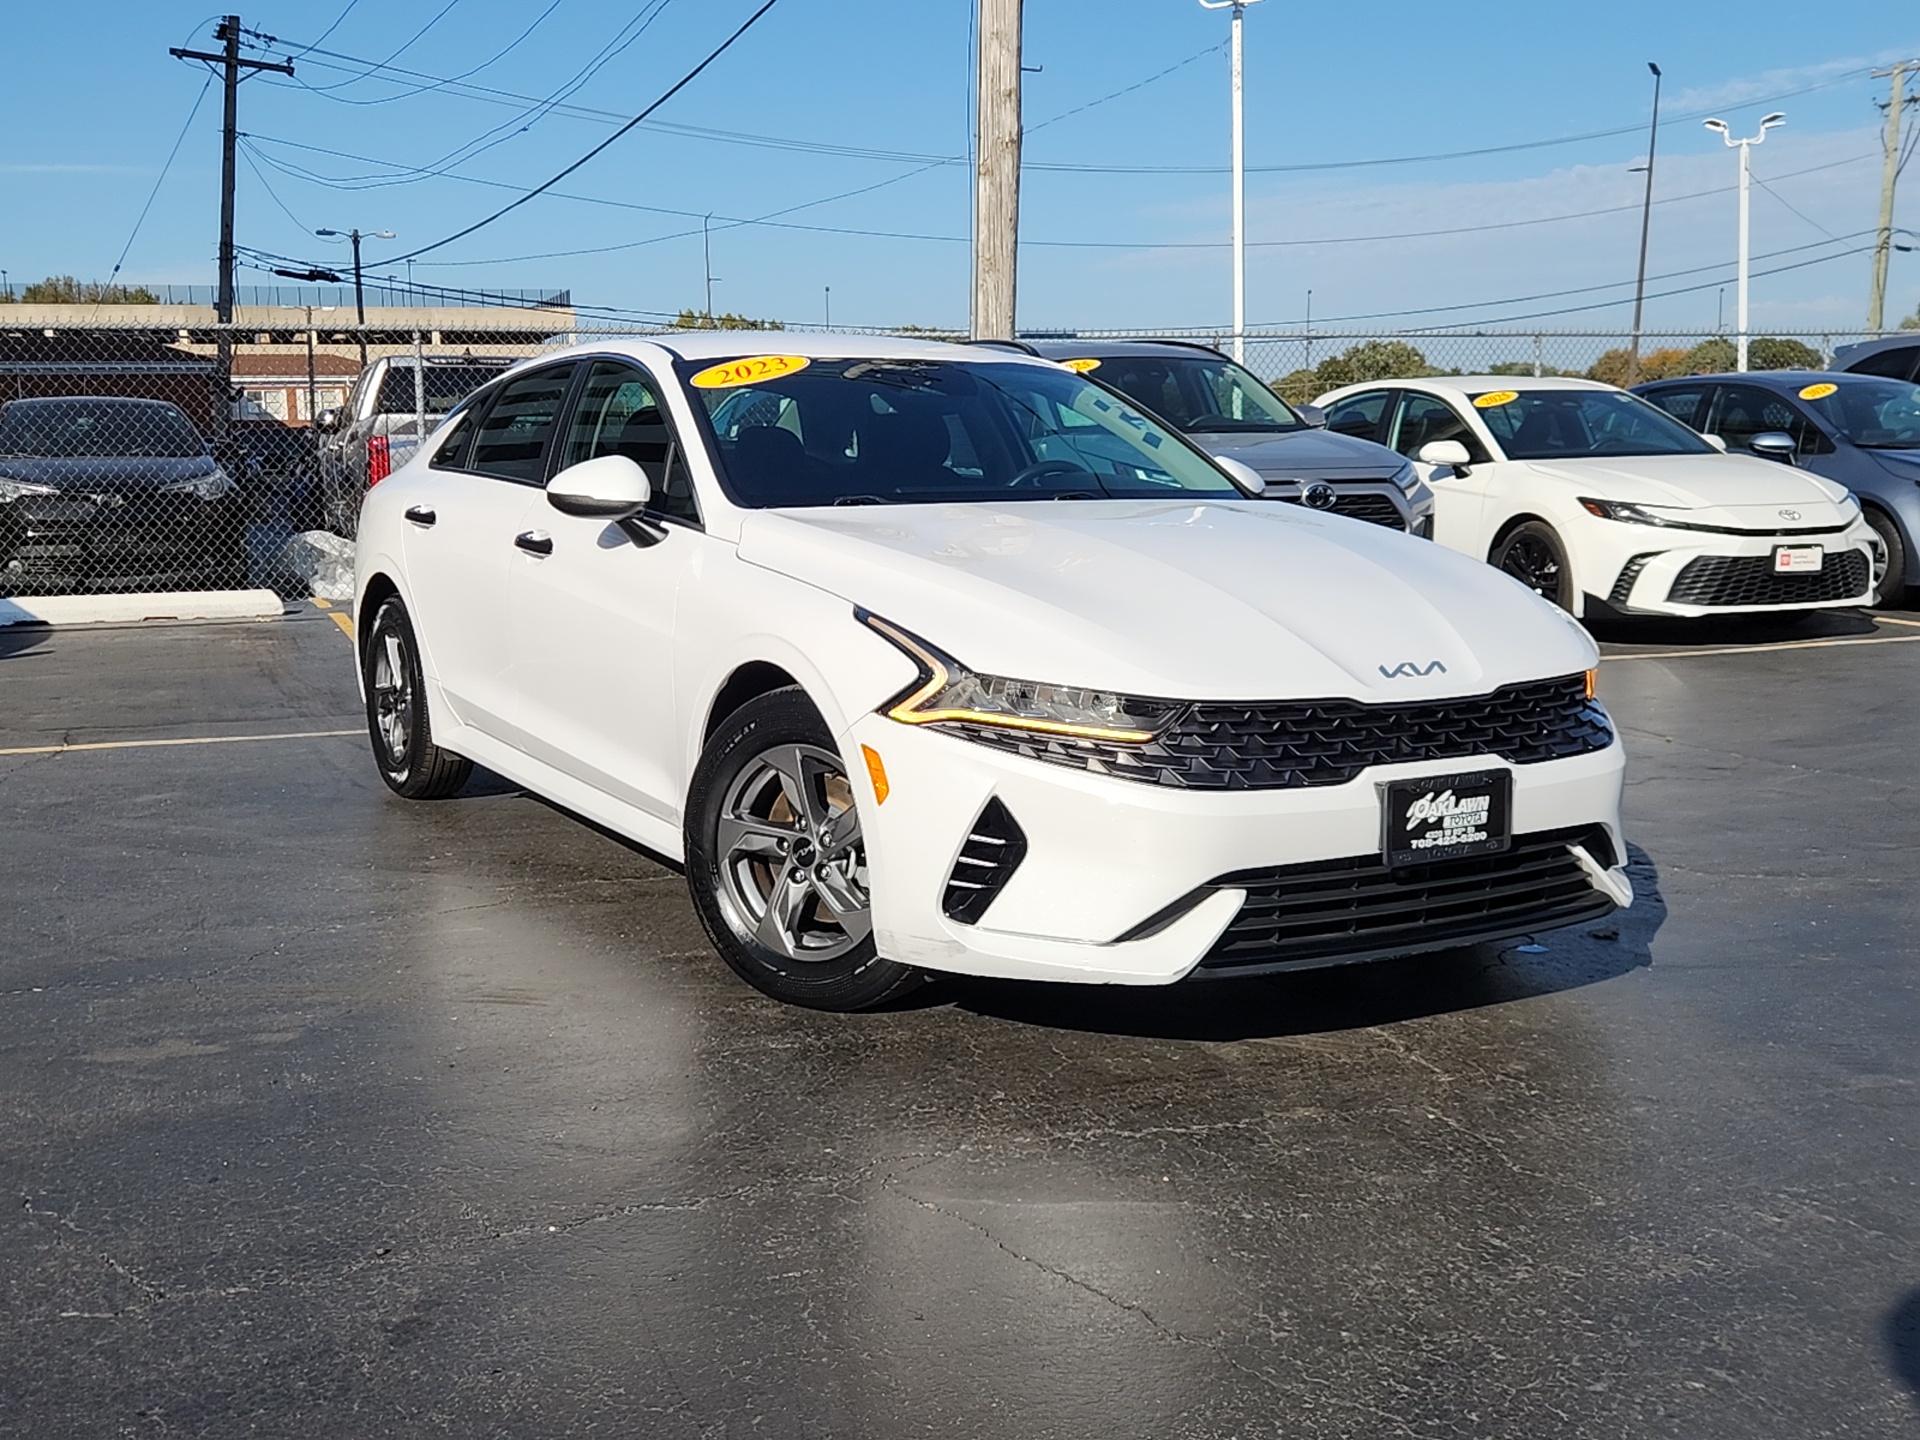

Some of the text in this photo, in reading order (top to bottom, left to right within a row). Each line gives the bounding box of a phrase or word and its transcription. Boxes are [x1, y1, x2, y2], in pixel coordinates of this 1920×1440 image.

[715, 357, 789, 384] 2023
[1480, 391, 1511, 405] 2025
[1378, 660, 1448, 679] KIA
[1449, 812, 1484, 826] TOYOTA
